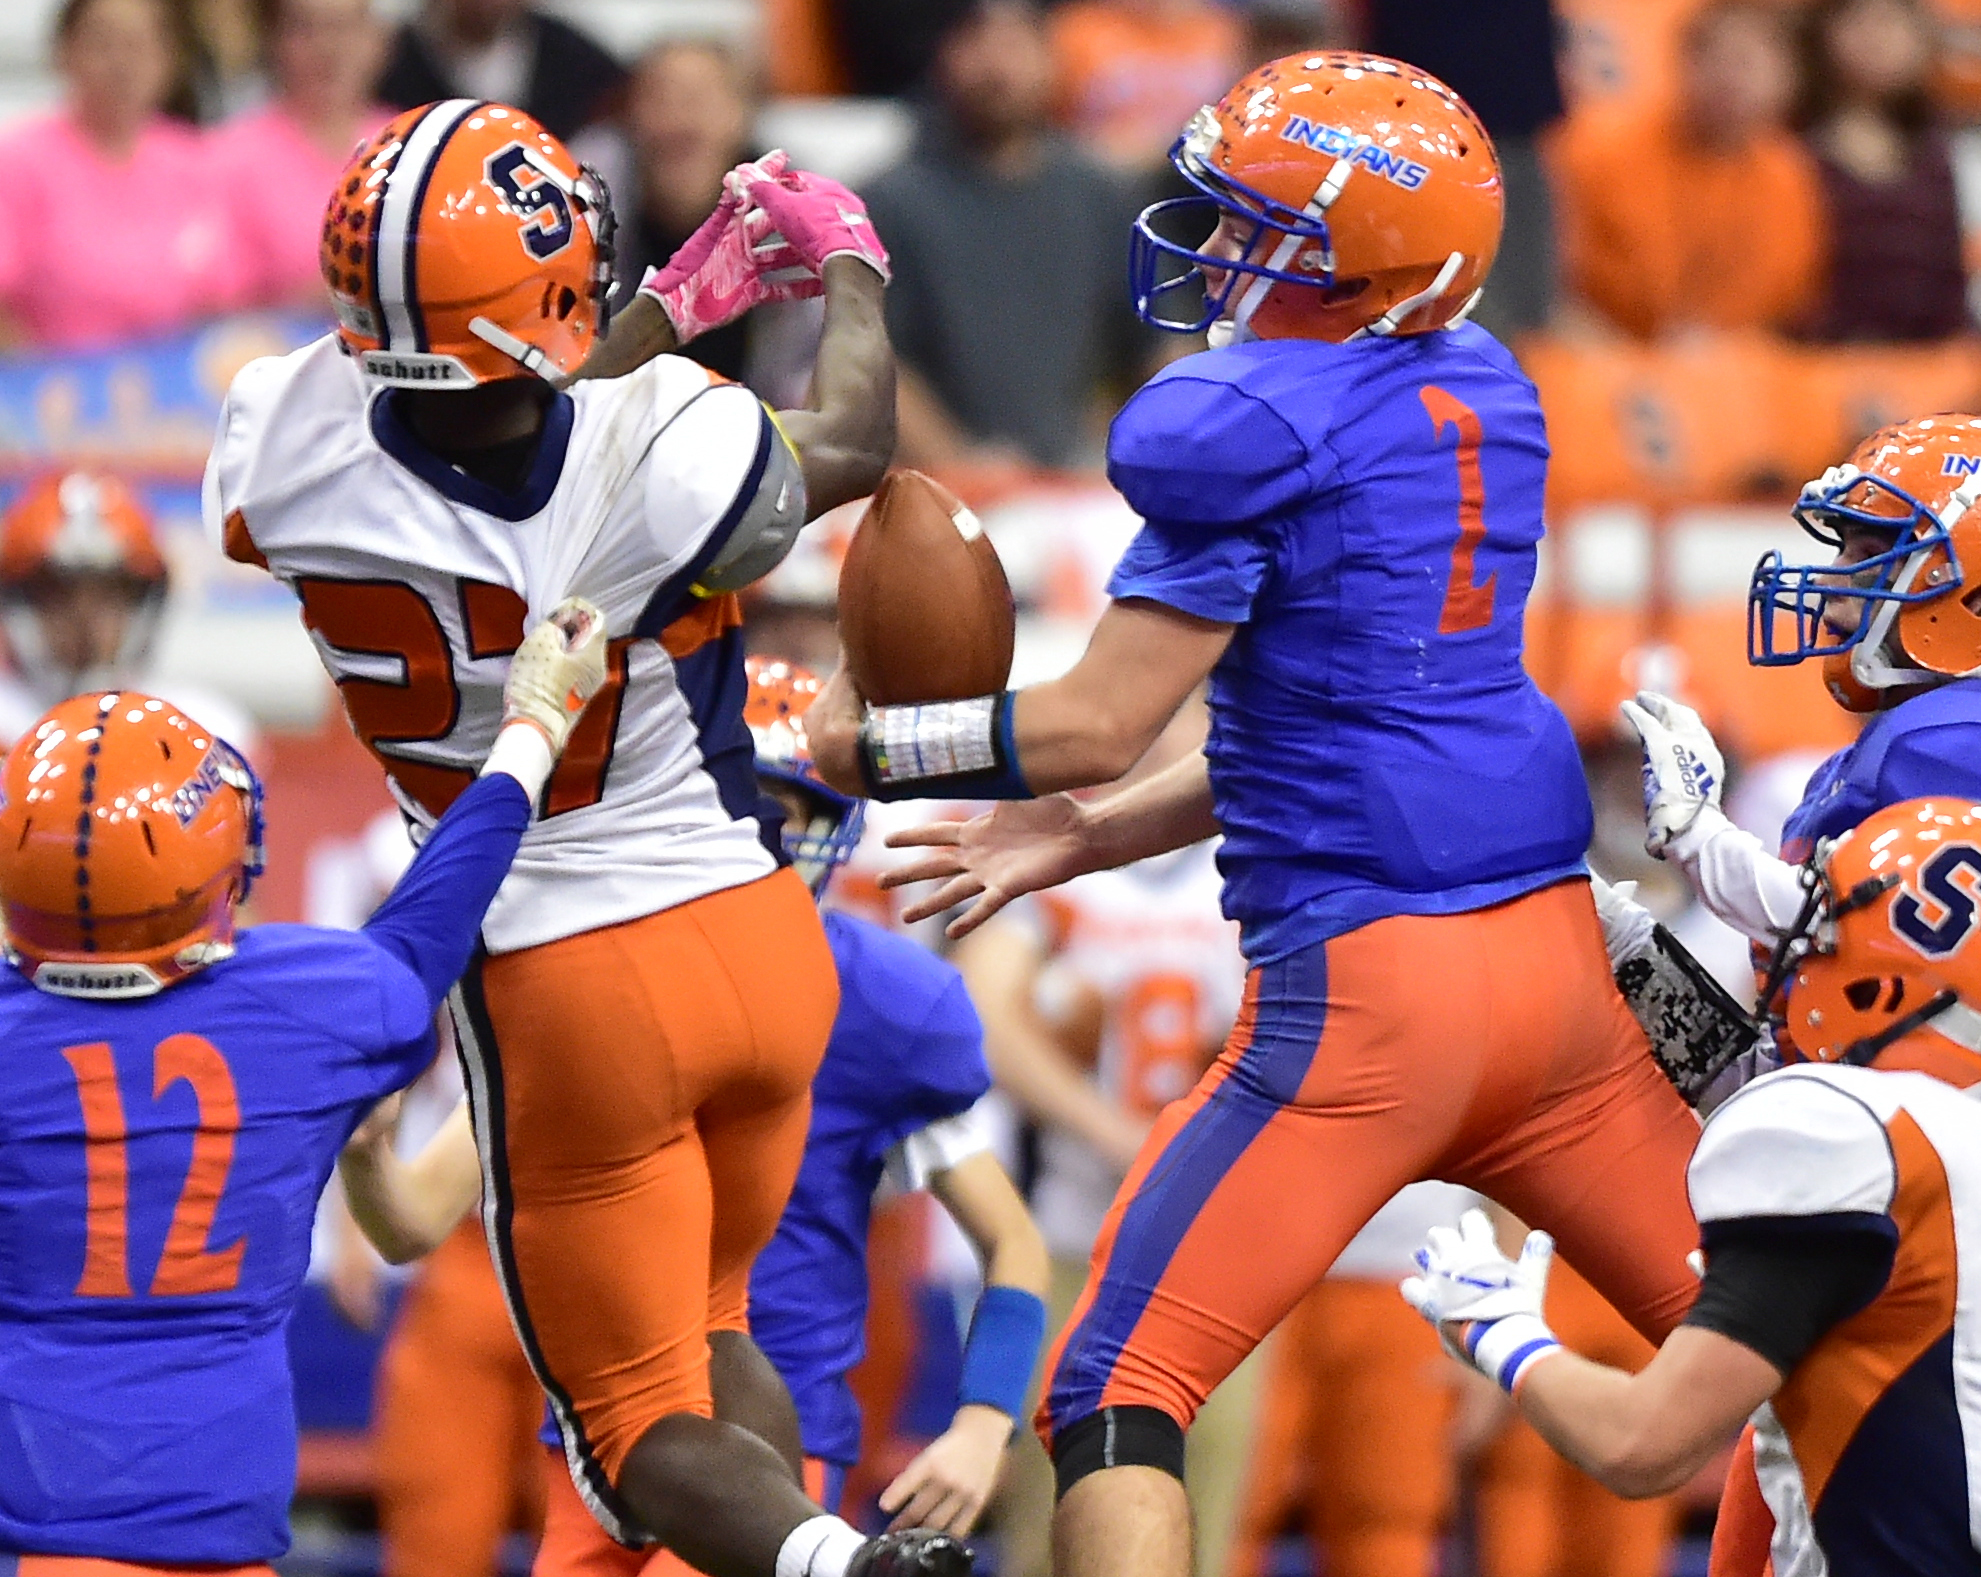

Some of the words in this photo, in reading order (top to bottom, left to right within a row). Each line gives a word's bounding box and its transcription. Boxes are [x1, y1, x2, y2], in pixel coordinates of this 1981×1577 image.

[1281, 115, 1430, 191] INDIANS
[1672, 744, 1699, 798] adida
[1888, 841, 1981, 961] S
[61, 1032, 247, 1297] 12
